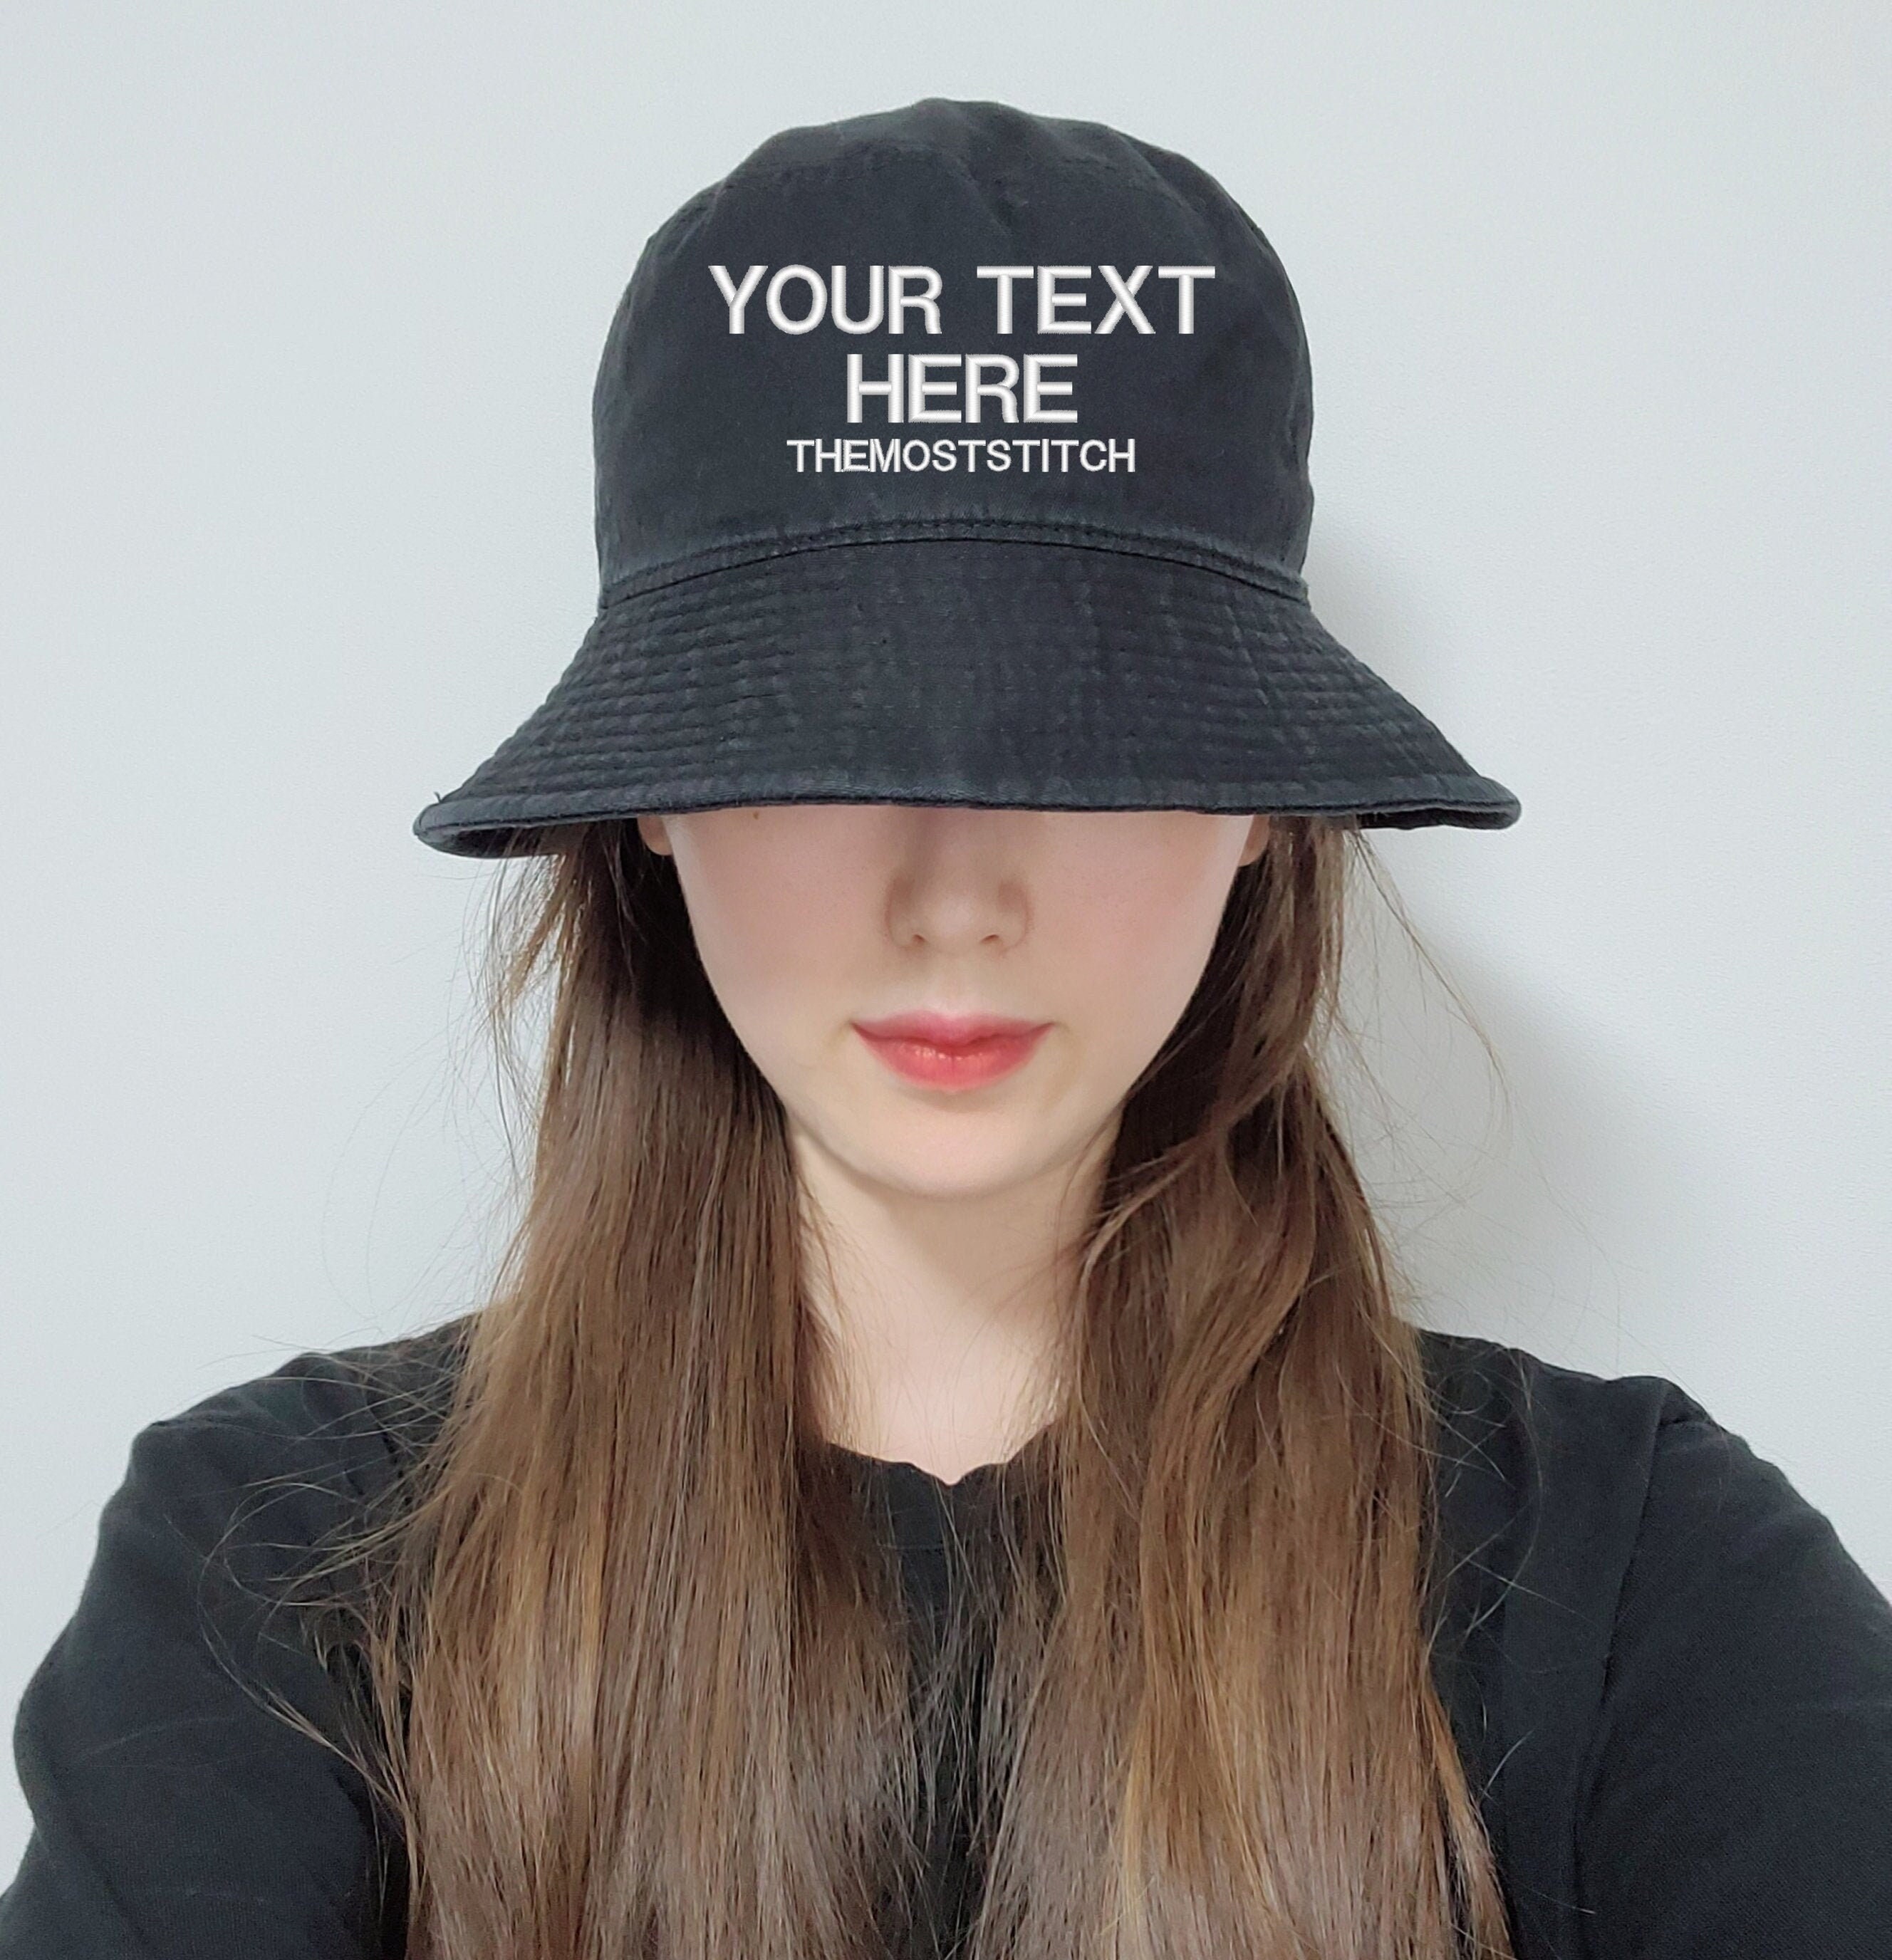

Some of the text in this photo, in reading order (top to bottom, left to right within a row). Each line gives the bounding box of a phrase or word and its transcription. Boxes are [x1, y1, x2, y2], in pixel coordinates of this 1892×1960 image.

[708, 264, 1215, 335] YOUR TEXT
[847, 353, 1077, 423] HERE
[786, 438, 1135, 472] THEMOSTSTITCH
